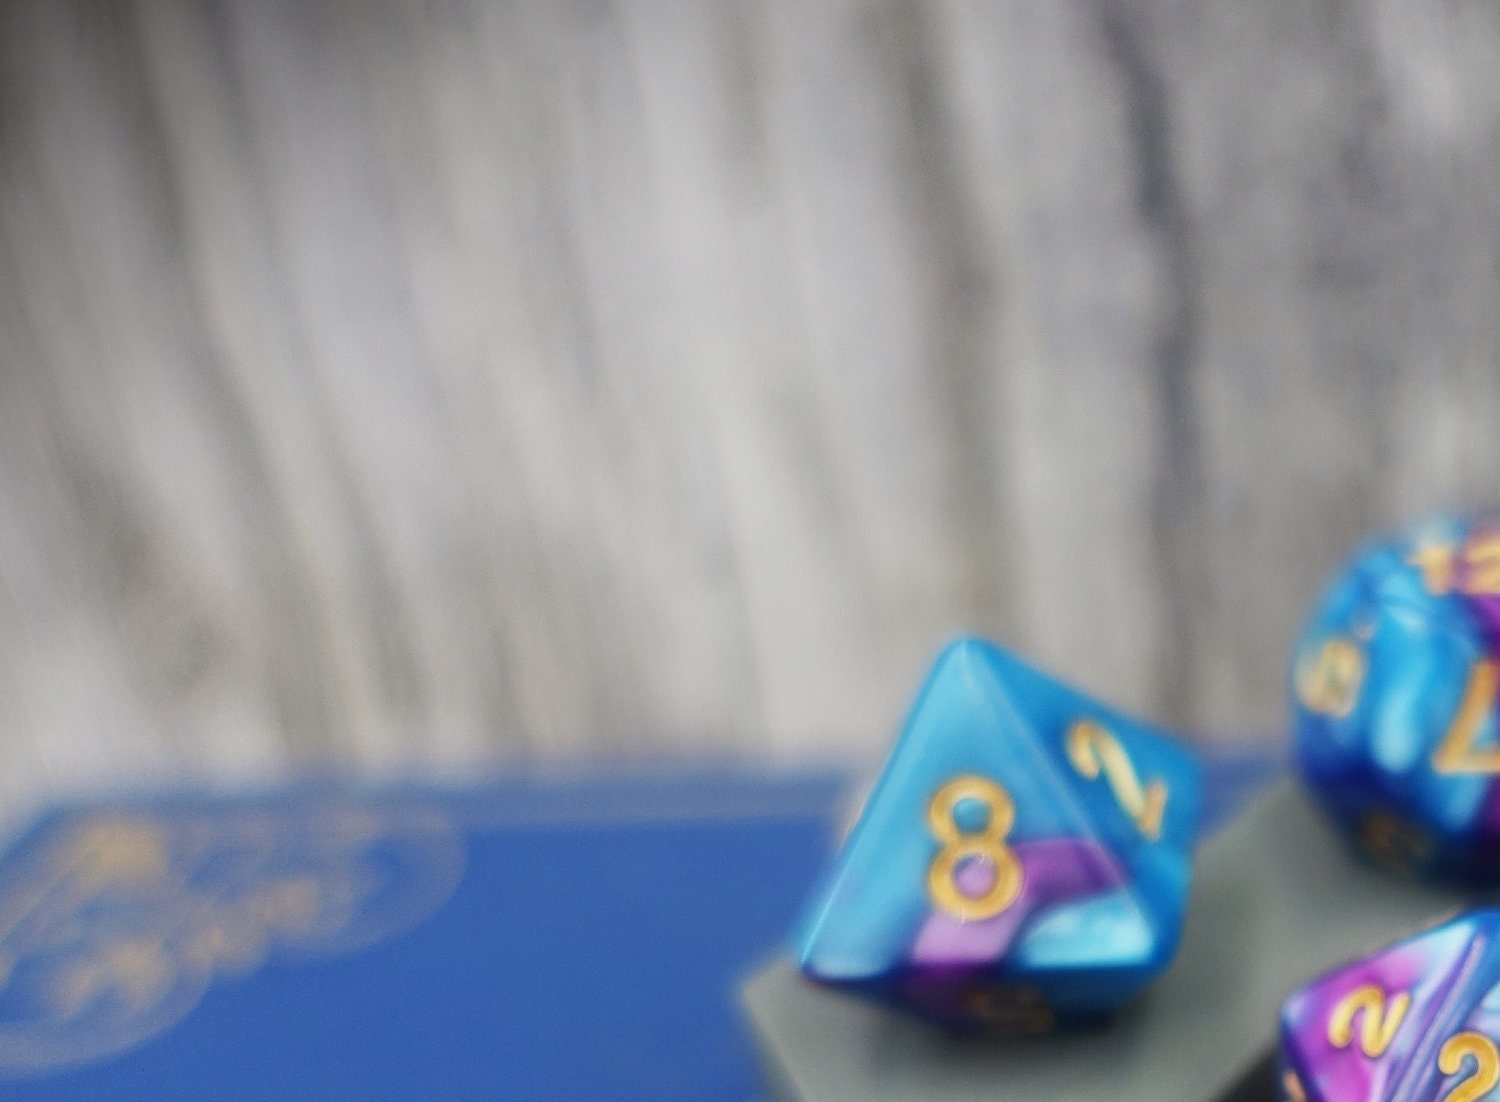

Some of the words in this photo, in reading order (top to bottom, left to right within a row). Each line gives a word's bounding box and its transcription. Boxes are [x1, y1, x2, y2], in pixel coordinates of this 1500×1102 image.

[1064, 718, 1169, 843] 2
[927, 774, 1024, 921] 8
[1327, 984, 1411, 1058] 2
